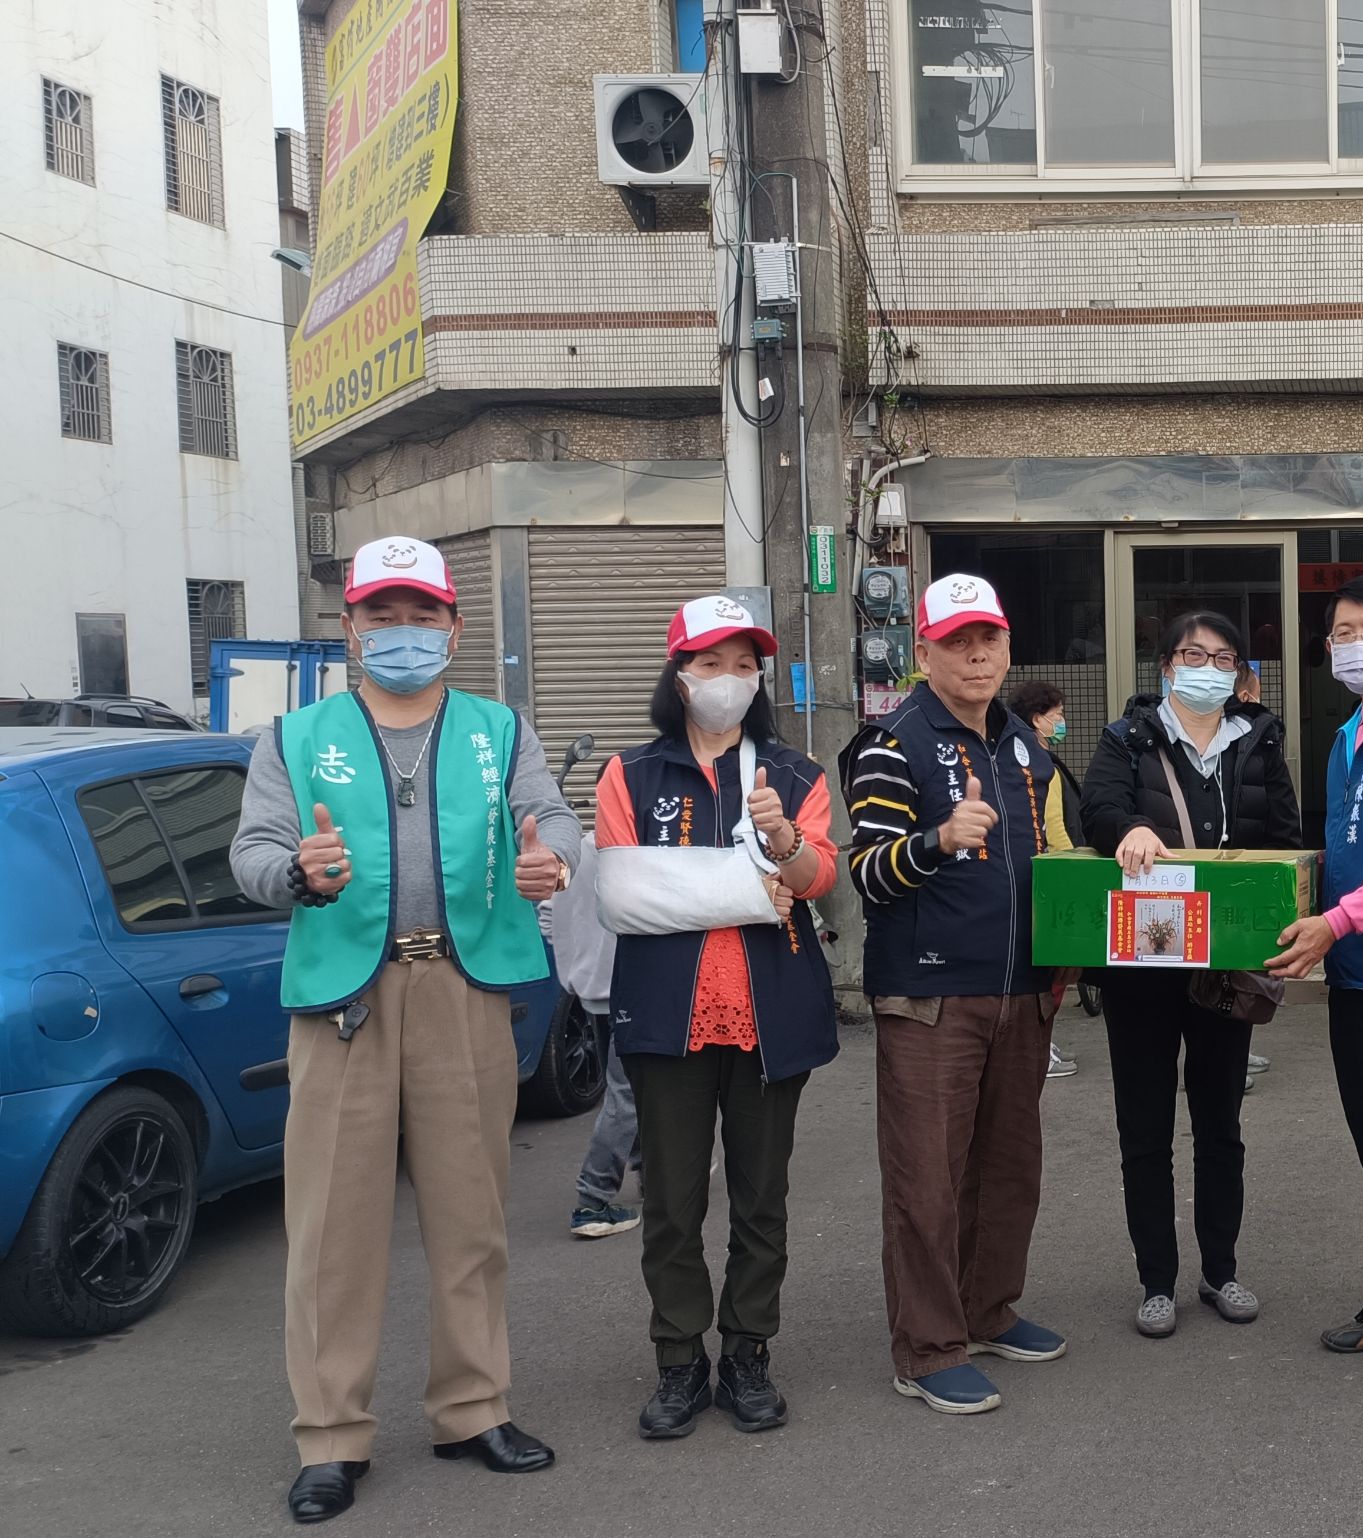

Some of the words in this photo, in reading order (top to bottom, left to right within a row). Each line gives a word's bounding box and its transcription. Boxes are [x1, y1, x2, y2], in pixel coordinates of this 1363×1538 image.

[294, 271, 417, 393] 0937-118806
[295, 327, 418, 437] 03-4899777
[471, 733, 501, 910] 隆祥經濟發展基金會
[948, 769, 964, 802] 主任
